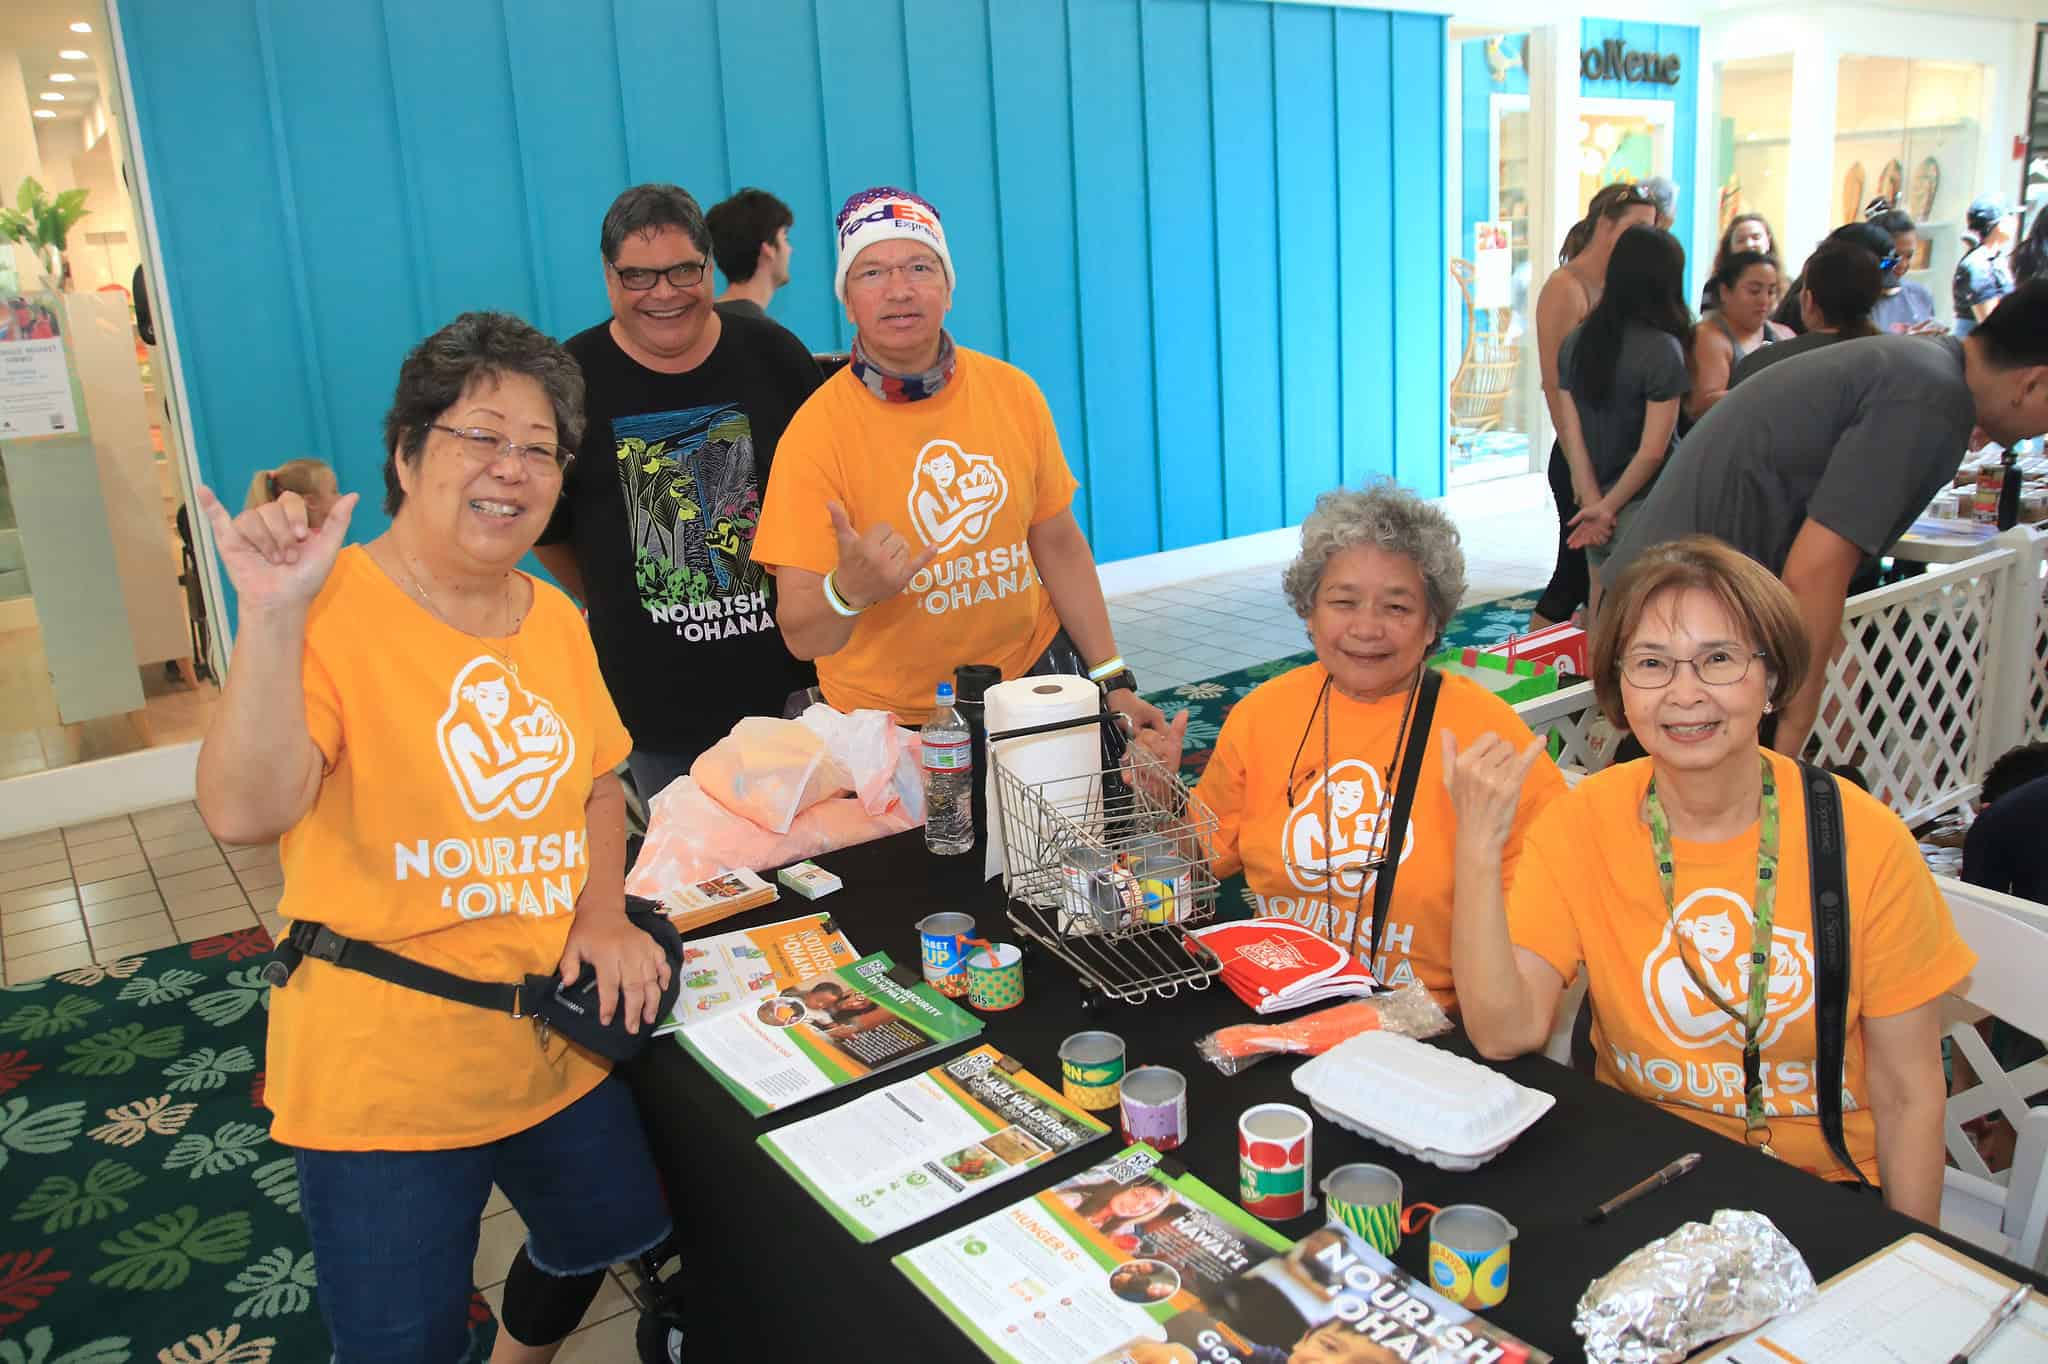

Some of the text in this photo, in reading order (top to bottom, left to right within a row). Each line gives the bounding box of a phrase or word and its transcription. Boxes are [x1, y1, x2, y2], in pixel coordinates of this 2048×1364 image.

[902, 542, 1029, 595] OURISH
[651, 590, 767, 624] NOURISH
[676, 611, 775, 642] ‘OHANA
[394, 829, 587, 881] NOURISH
[441, 875, 576, 919] ‘OHAN
[922, 945, 951, 965] UP
[1007, 1094, 1078, 1141] WILDFIRES
[1010, 1208, 1066, 1252] HUNGER
[1316, 1243, 1505, 1364] NOURISH
